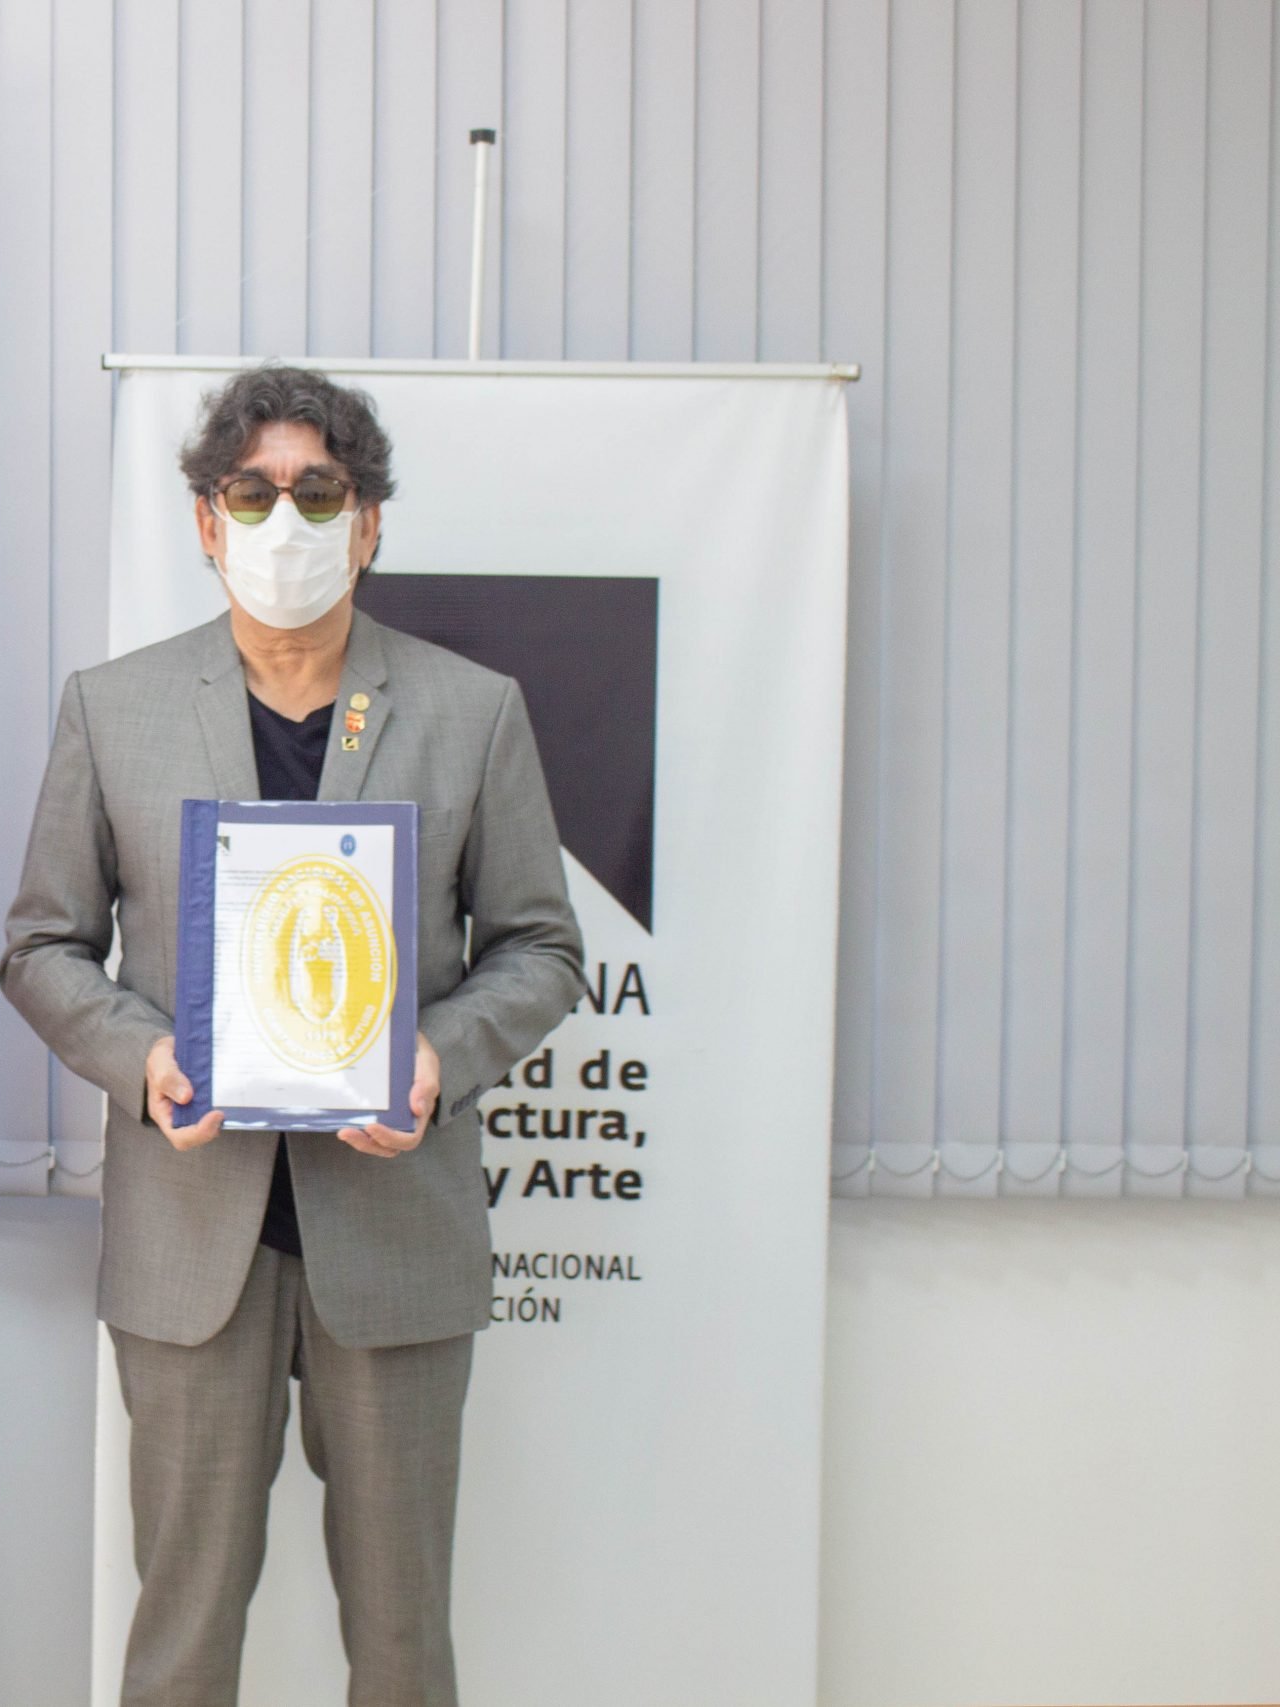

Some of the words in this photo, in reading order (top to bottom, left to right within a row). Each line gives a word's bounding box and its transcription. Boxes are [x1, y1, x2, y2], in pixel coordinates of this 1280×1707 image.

[571, 962, 651, 1016] NA
[580, 1049, 648, 1091] de
[482, 1166, 510, 1208] y
[522, 1159, 643, 1200] Arte
[492, 1252, 642, 1281] NACIONAL
[489, 1287, 562, 1323] CIÓN
